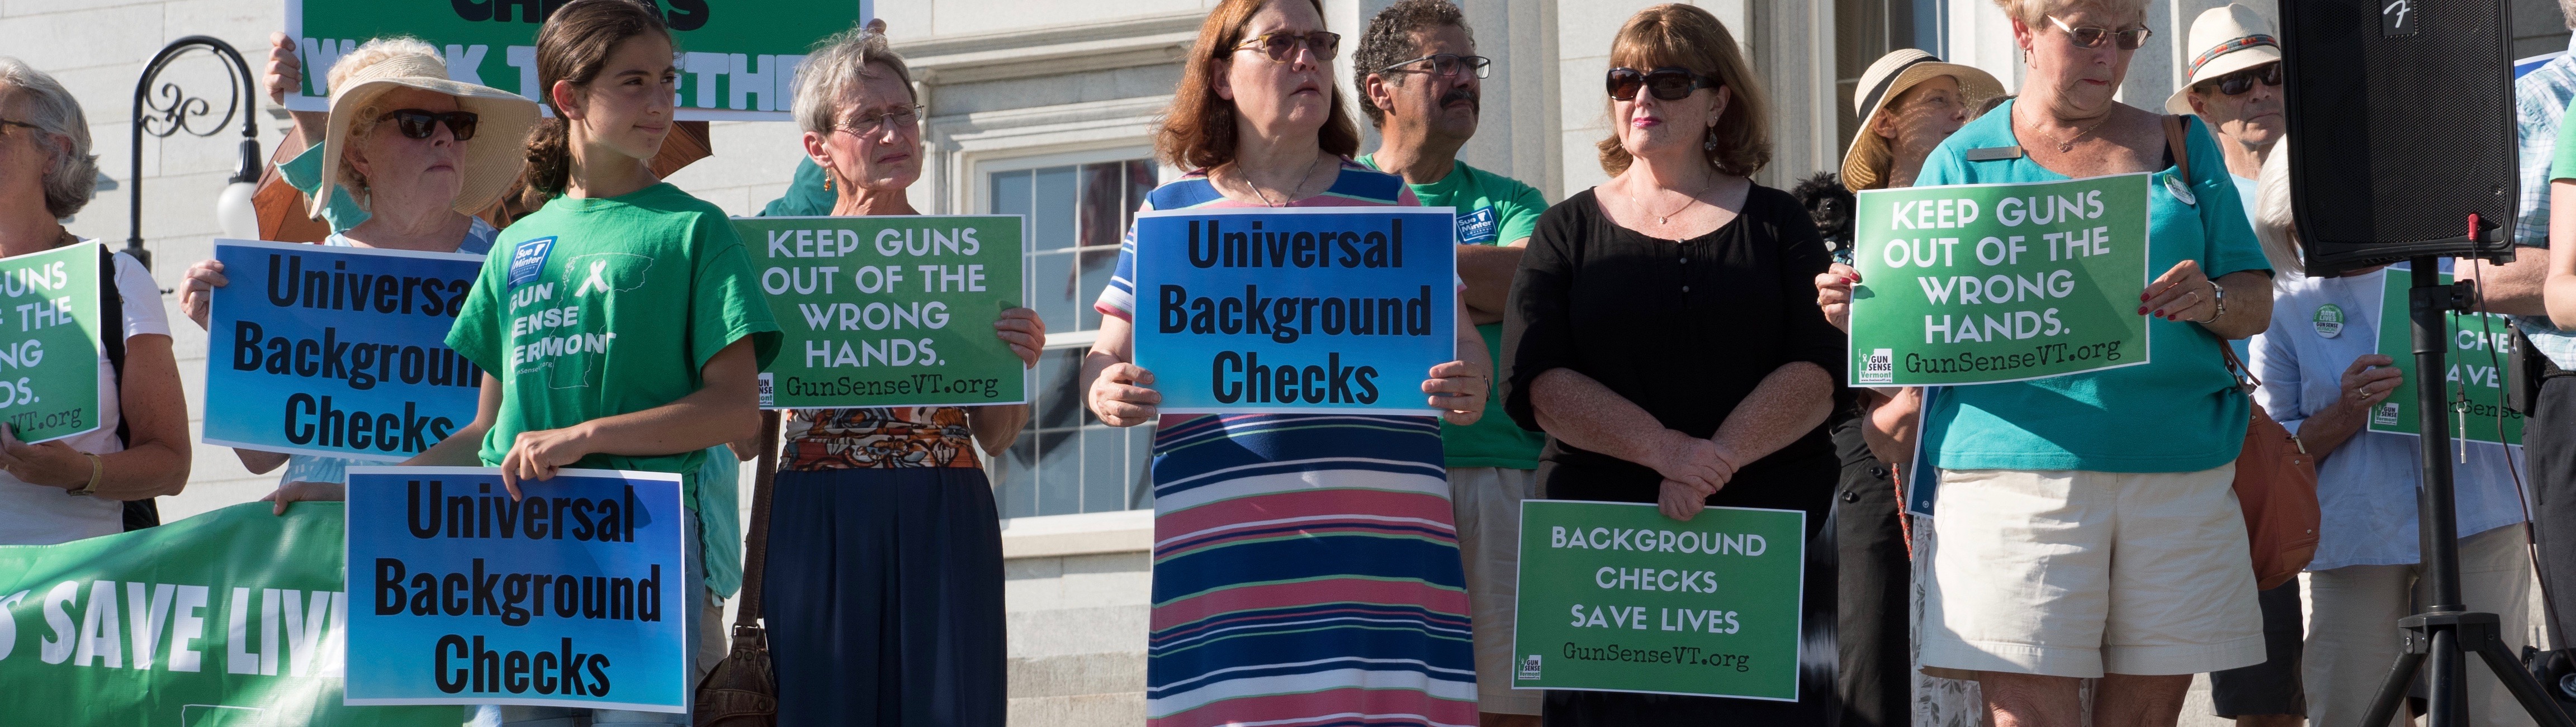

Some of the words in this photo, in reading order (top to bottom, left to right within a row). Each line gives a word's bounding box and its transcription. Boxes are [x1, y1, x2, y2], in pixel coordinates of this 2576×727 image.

[1458, 217, 1476, 226] Sue
[1461, 220, 1492, 232] Minter
[1892, 198, 1979, 230] KEEP
[1996, 190, 2104, 226] GUNS
[517, 248, 533, 259] Sue
[768, 229, 859, 258] KEEP
[875, 227, 979, 257] GUNS
[1187, 218, 1403, 269] Universal
[1883, 238, 1959, 268] OUT
[1976, 236, 2027, 265] OF
[2043, 226, 2110, 260] THE
[513, 256, 542, 269] Minter
[762, 266, 839, 295] OUT
[855, 265, 902, 293] OF
[918, 264, 986, 292] THE
[267, 254, 480, 319] Universa
[509, 282, 554, 315] GUN
[1917, 269, 2075, 306] WRONG
[16, 296, 72, 332] THE
[799, 301, 950, 331] WRONG
[1159, 284, 1432, 344] Background
[1925, 308, 2071, 344] HANDS.
[233, 320, 481, 390] Backgroun
[806, 338, 945, 368] HANDS.
[1905, 340, 2121, 375] GunSenseVT.org
[786, 374, 998, 398] GunSenseVT.org
[1212, 350, 1379, 405] Checks
[2446, 364, 2501, 388] AVE
[407, 480, 634, 543] Universal
[1551, 526, 1767, 557] BACKGROUND
[375, 558, 661, 627] Background
[1595, 567, 1717, 593] CHECKS
[41, 580, 209, 672] SAVE
[1570, 604, 1647, 630] SAVE
[1661, 608, 1740, 635] LIVES
[434, 634, 610, 698] Checks
[1563, 642, 1750, 673] GunSenseVT.org
